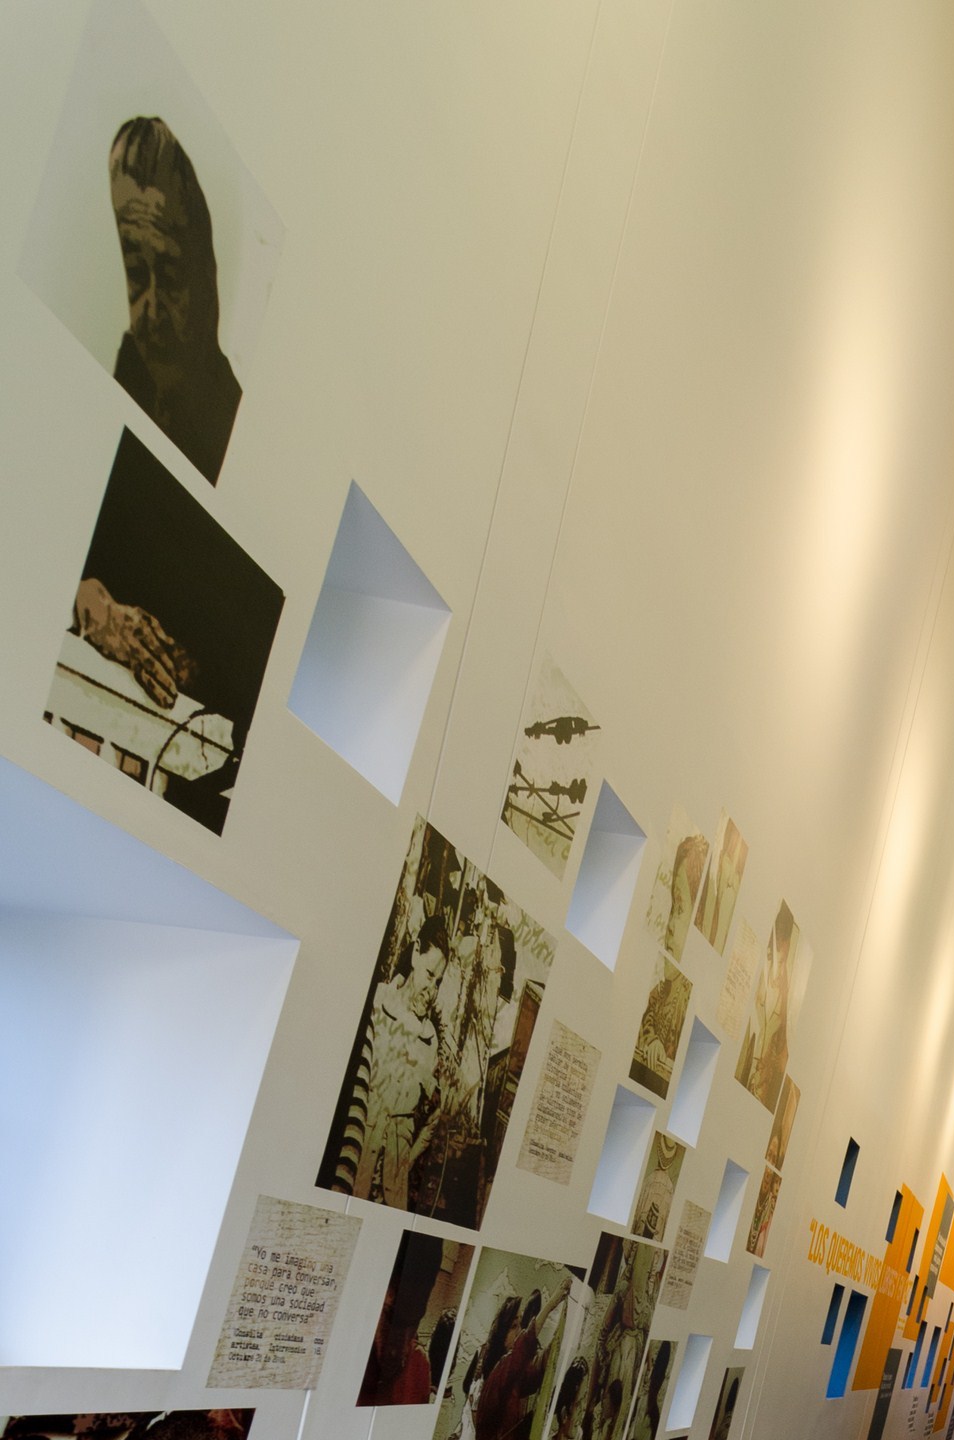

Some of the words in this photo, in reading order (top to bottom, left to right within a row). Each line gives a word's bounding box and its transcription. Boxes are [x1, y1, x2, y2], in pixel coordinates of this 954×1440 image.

[270, 1252, 281, 1262] me
[320, 1262, 333, 1273] una
[825, 1231, 866, 1283] QUEREMOS
[248, 1262, 268, 1274] casa
[271, 1267, 292, 1279] para
[296, 1272, 337, 1290] conversar,
[244, 1277, 275, 1291] porque
[279, 1283, 298, 1294] creo
[301, 1287, 315, 1298] que
[238, 1306, 254, 1317] que
[258, 1309, 269, 1318] no
[242, 1292, 267, 1303] somos
[271, 1297, 286, 1306] una
[289, 1298, 325, 1312] sociedad
